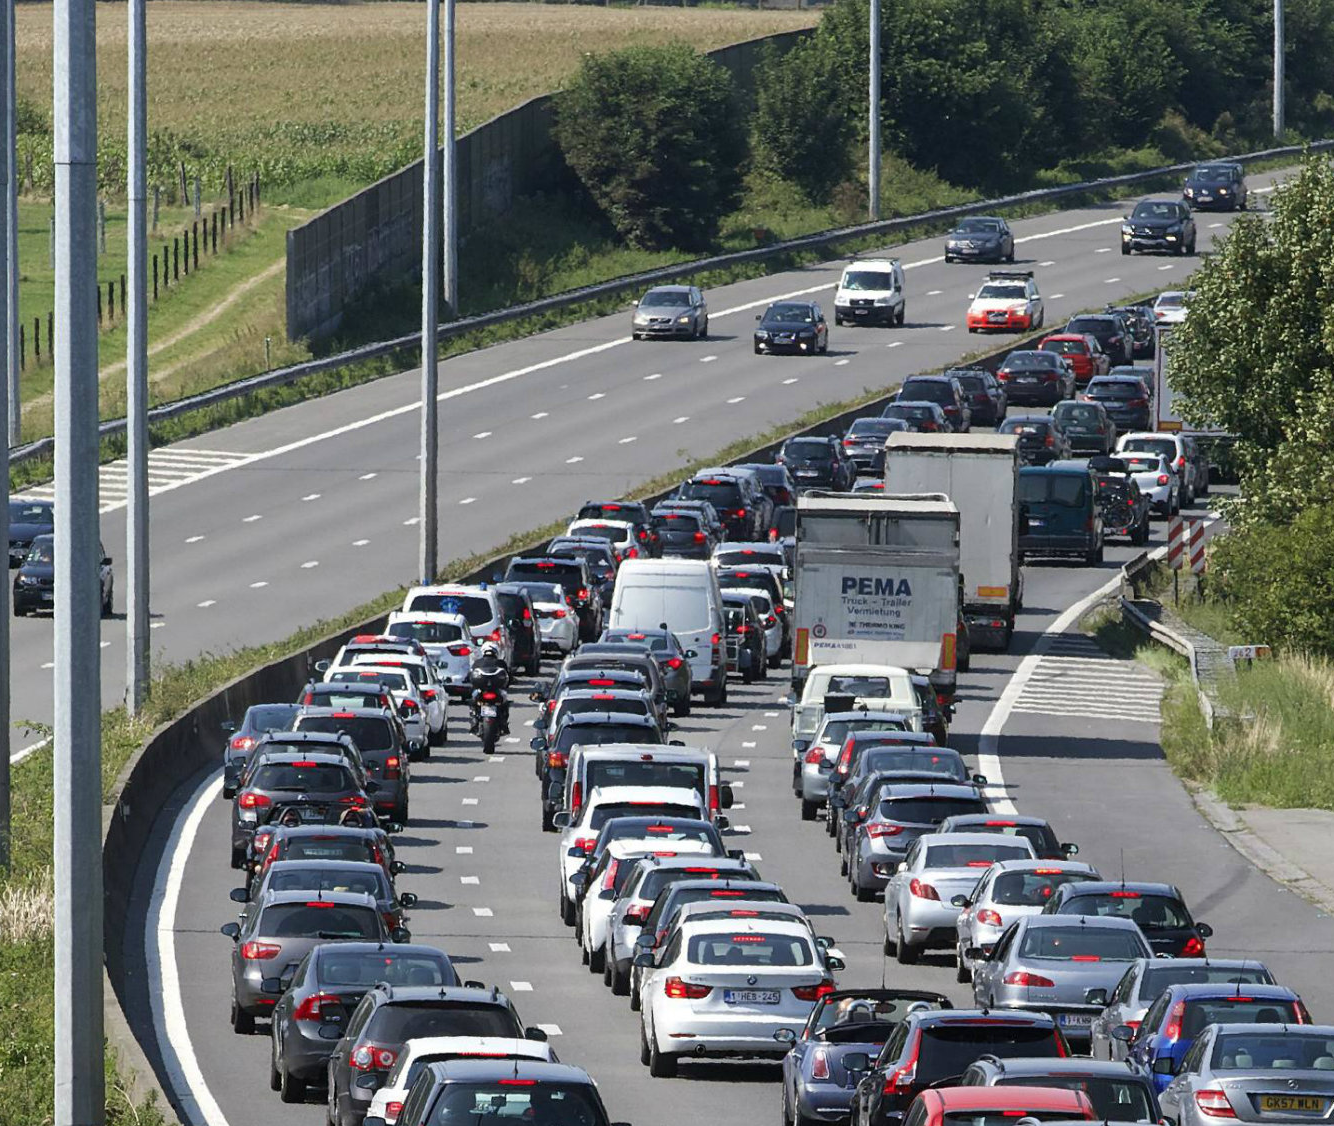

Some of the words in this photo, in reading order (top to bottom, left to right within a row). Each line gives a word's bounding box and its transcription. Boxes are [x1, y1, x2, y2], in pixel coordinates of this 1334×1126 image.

[841, 576, 912, 596] PEMA
[841, 596, 868, 605] Truck
[882, 598, 912, 607] Trailer
[847, 607, 901, 618] Vermietung
